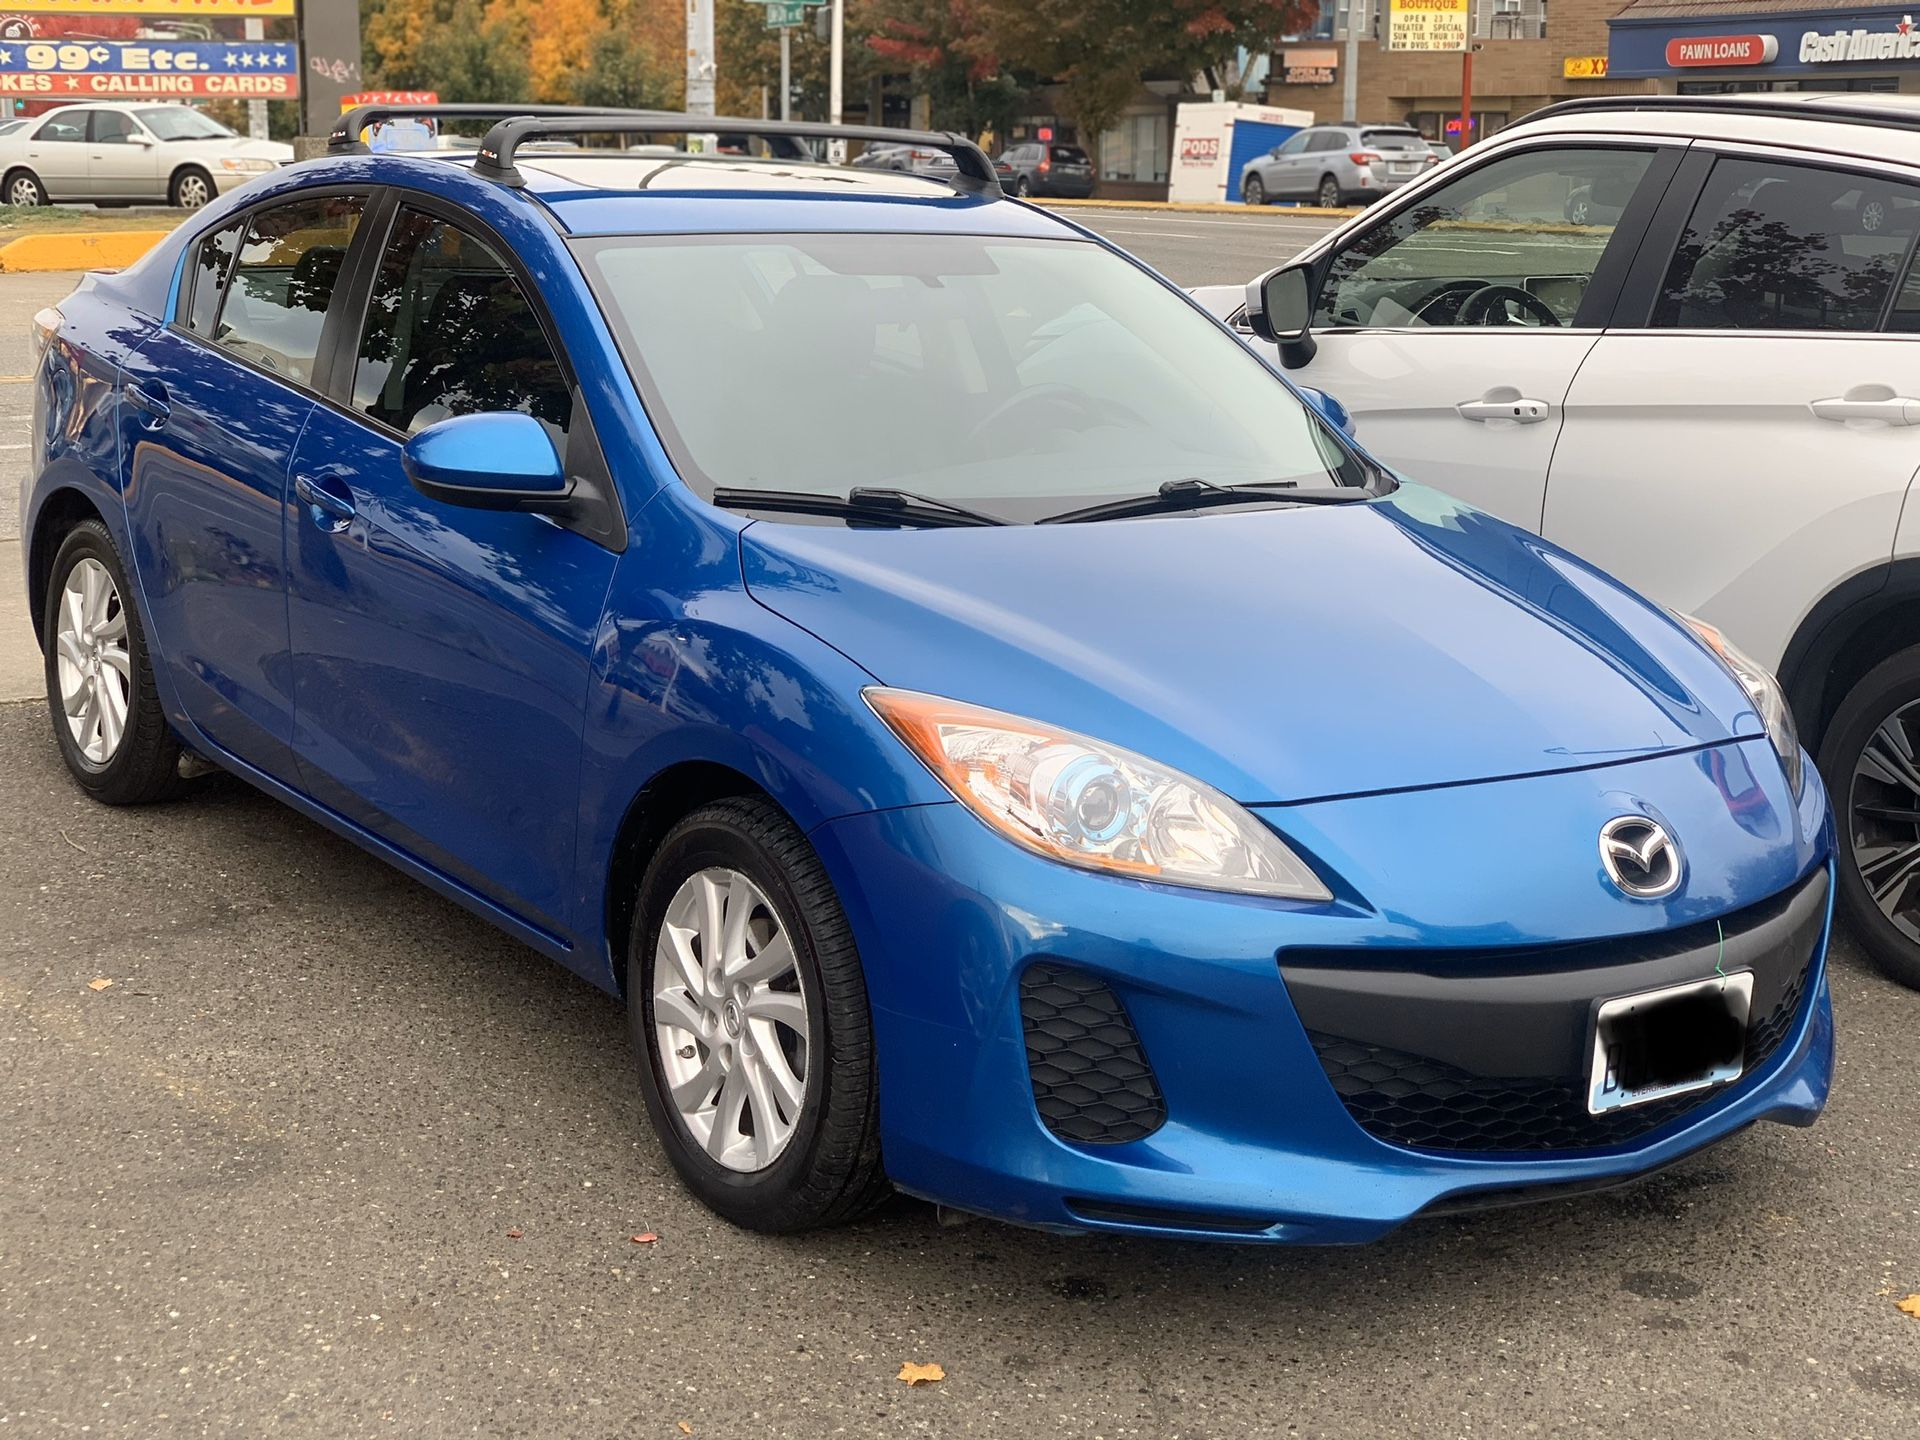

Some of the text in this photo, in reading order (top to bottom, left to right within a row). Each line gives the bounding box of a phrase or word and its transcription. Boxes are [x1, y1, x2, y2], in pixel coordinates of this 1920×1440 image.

[1400, 0, 1458, 11] BOUTIQUE
[1393, 32, 1407, 40] SUN
[1412, 32, 1425, 40] TUE
[1429, 32, 1448, 40] THUR
[1392, 41, 1407, 49] NEW
[1410, 41, 1429, 49] DVDS
[1679, 42, 1750, 60] PAWN LOANS
[1799, 31, 1850, 63] Cash
[25, 45, 210, 70] 99¢ Etc.
[0, 75, 287, 92] KES CALLING CARDS
[1183, 140, 1218, 154] PODS
